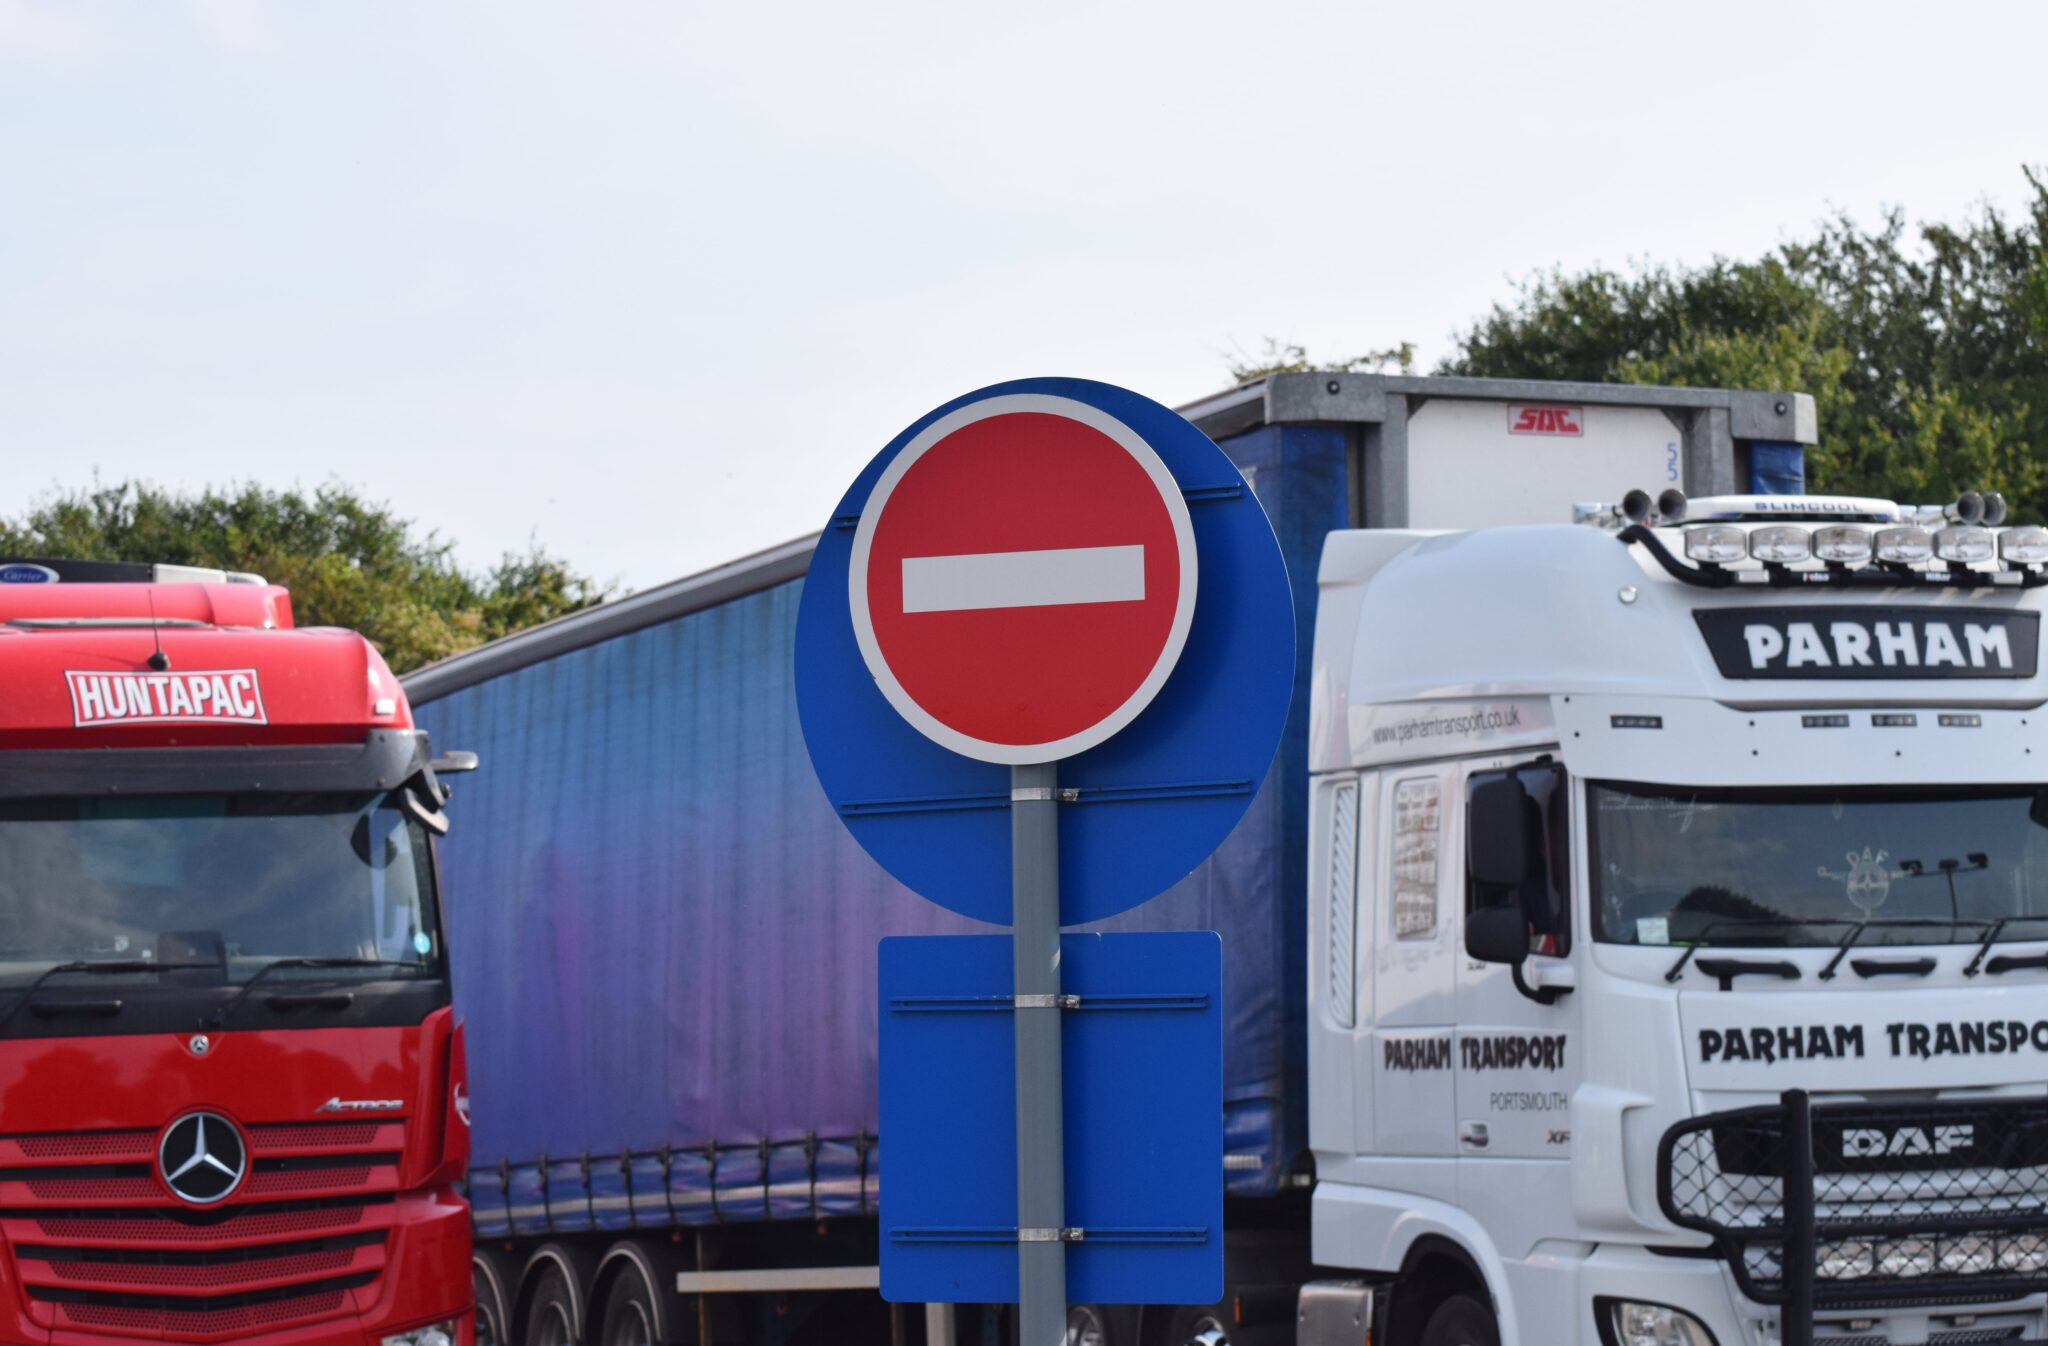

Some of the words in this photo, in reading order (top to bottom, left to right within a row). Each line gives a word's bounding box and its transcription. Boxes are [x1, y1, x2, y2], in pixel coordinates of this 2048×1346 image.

[1754, 502, 1864, 513] SLIMCOOL
[3, 569, 43, 582] Carrier
[1744, 621, 2013, 670] PARHAM
[76, 674, 257, 720] HUNTAPAC
[1373, 704, 1520, 745] www.parhamtransport.co.uk
[1384, 1037, 1451, 1073] PARHAM
[1460, 1034, 1567, 1073] TRANSPORT
[1700, 1025, 1865, 1064] PARHAM
[1490, 1092, 1568, 1111] PORTSMOUTH
[1842, 1124, 1974, 1157] DAF
